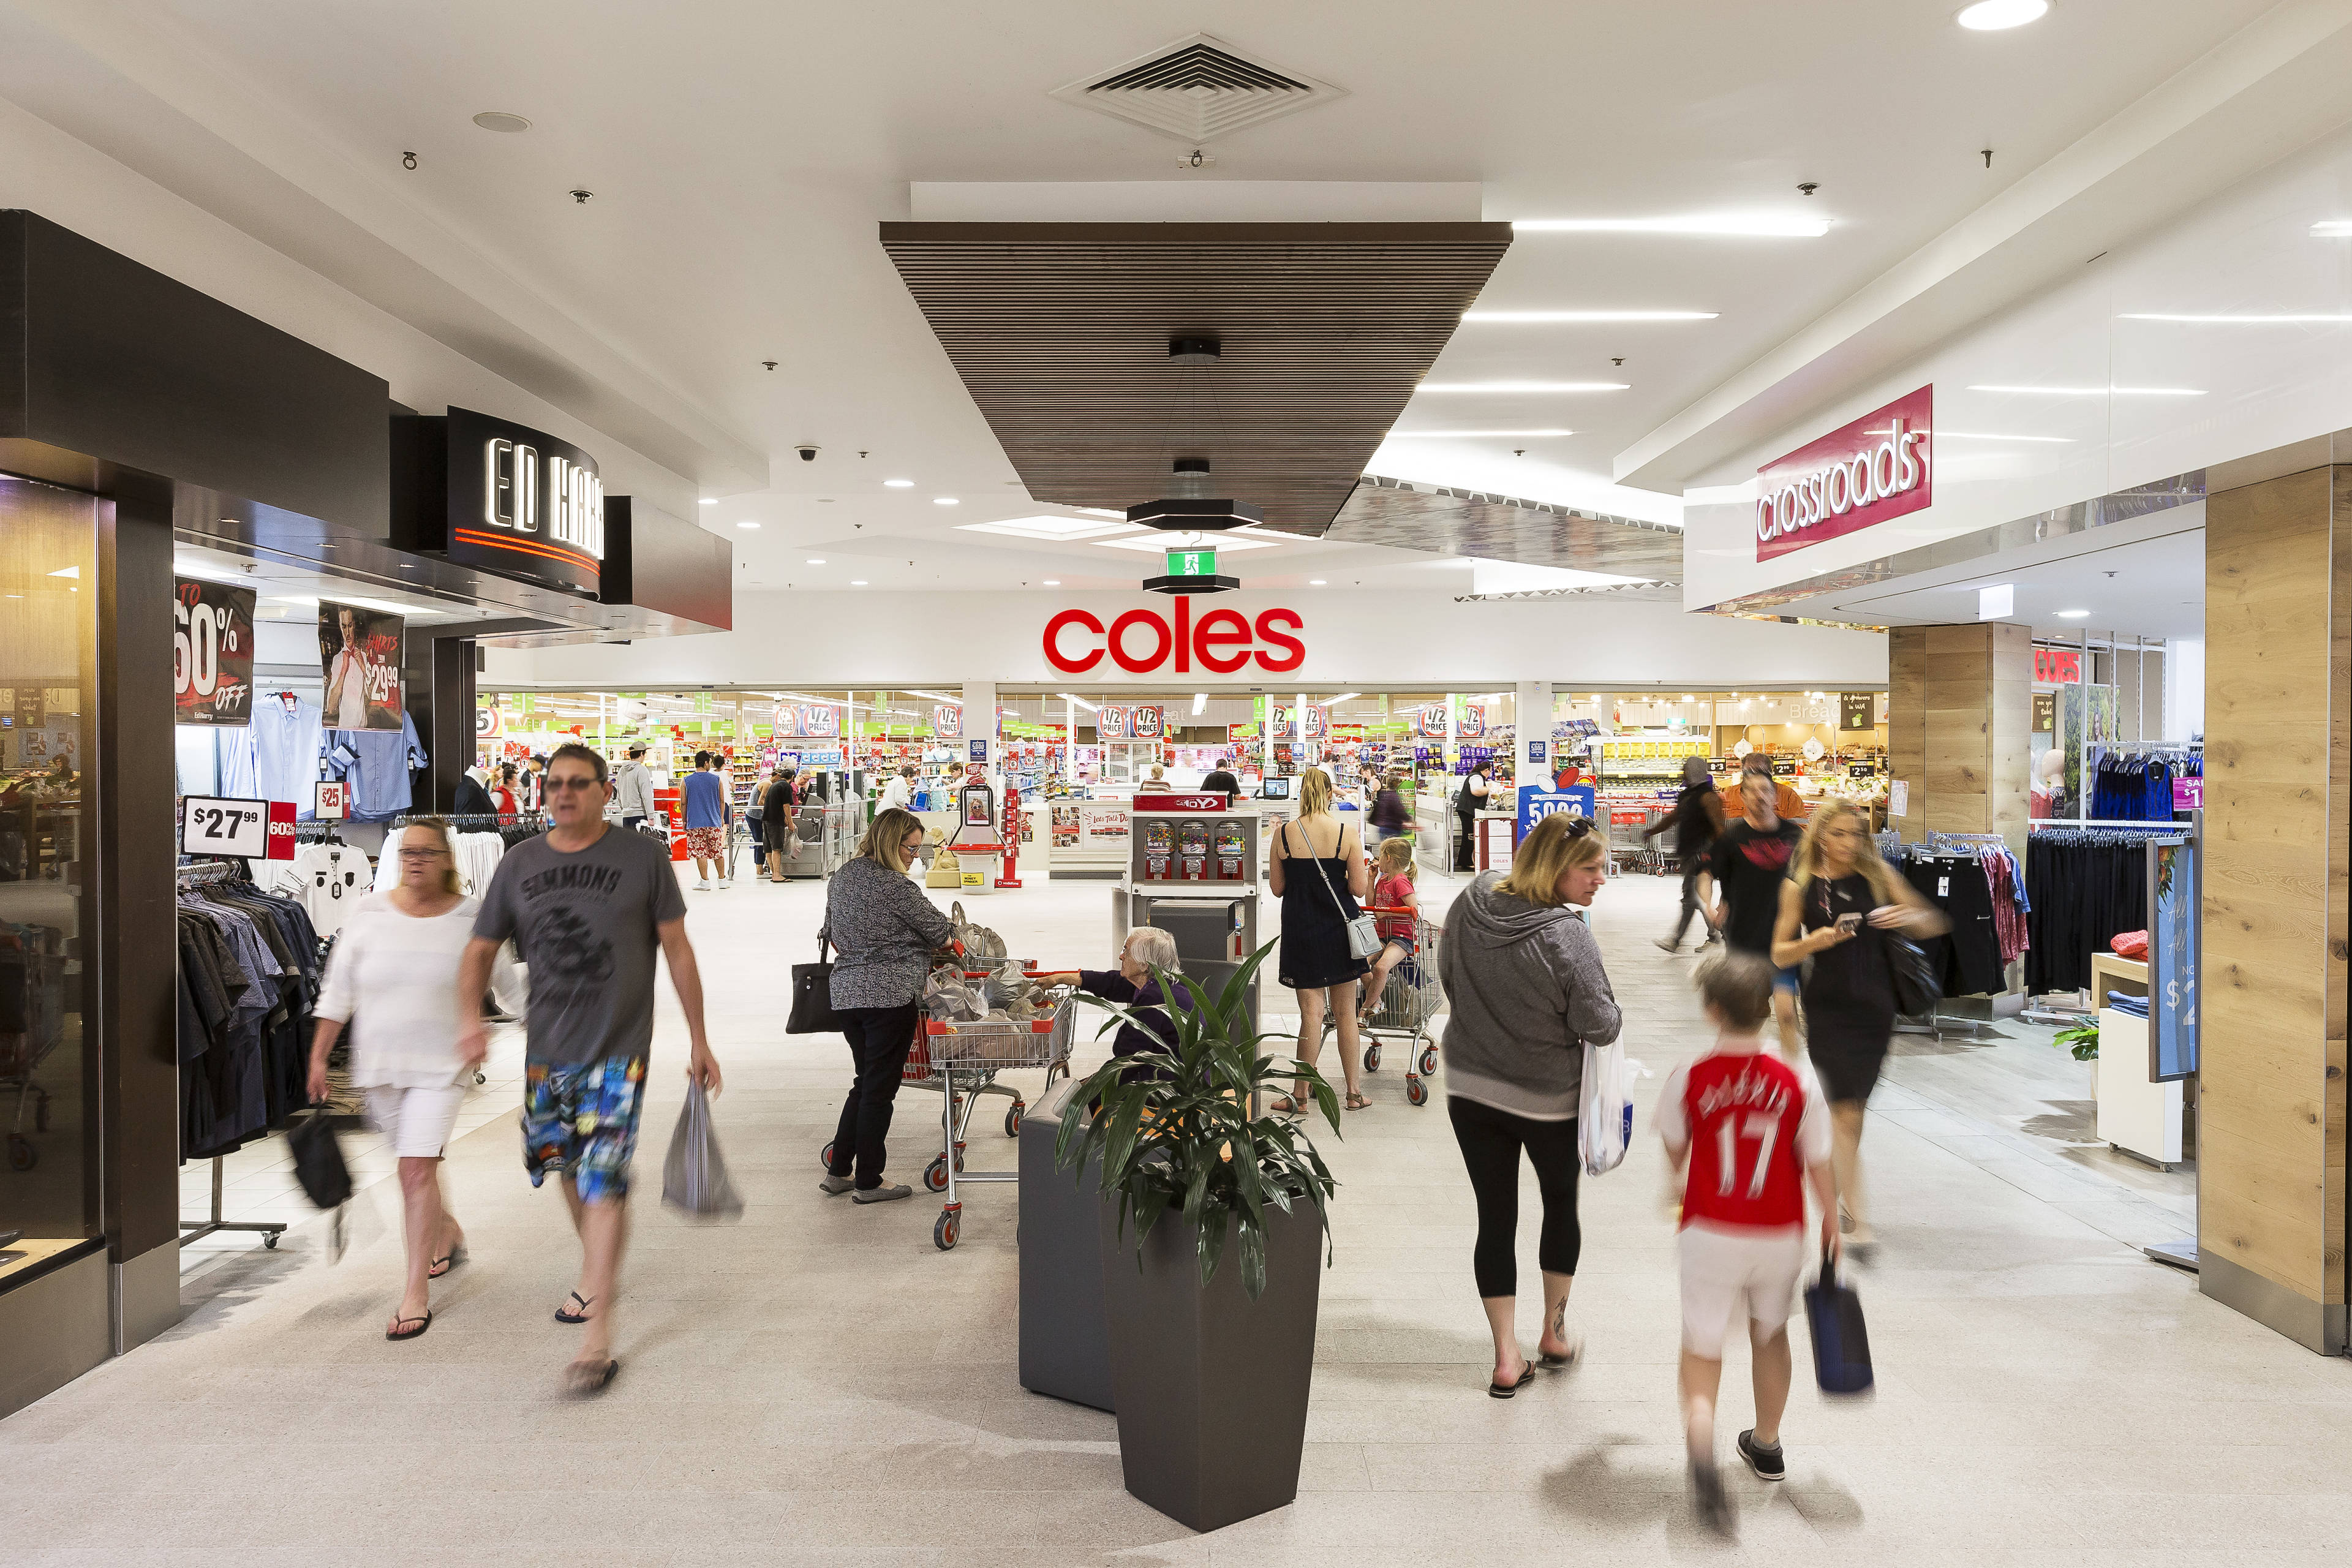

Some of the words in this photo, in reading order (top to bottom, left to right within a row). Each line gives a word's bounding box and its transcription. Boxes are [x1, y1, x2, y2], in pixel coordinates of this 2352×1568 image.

[485, 438, 538, 532] ED
[1757, 419, 1918, 542] crossroads
[179, 583, 201, 608] TO
[1042, 595, 1306, 673] coles
[216, 684, 248, 712] OFF
[810, 707, 829, 722] 1/2
[941, 708, 956, 723] 1/2
[1104, 709, 1120, 723] 1/2
[1138, 709, 1156, 724] 1/2
[1163, 708, 1186, 721] eat
[1273, 709, 1285, 722] /2
[1306, 709, 1317, 722] /2
[1428, 709, 1446, 722] 1/2
[322, 788, 339, 807] $25
[270, 822, 295, 836] 60%
[2182, 966, 2195, 975] NO
[1715, 1109, 1781, 1200] 17
